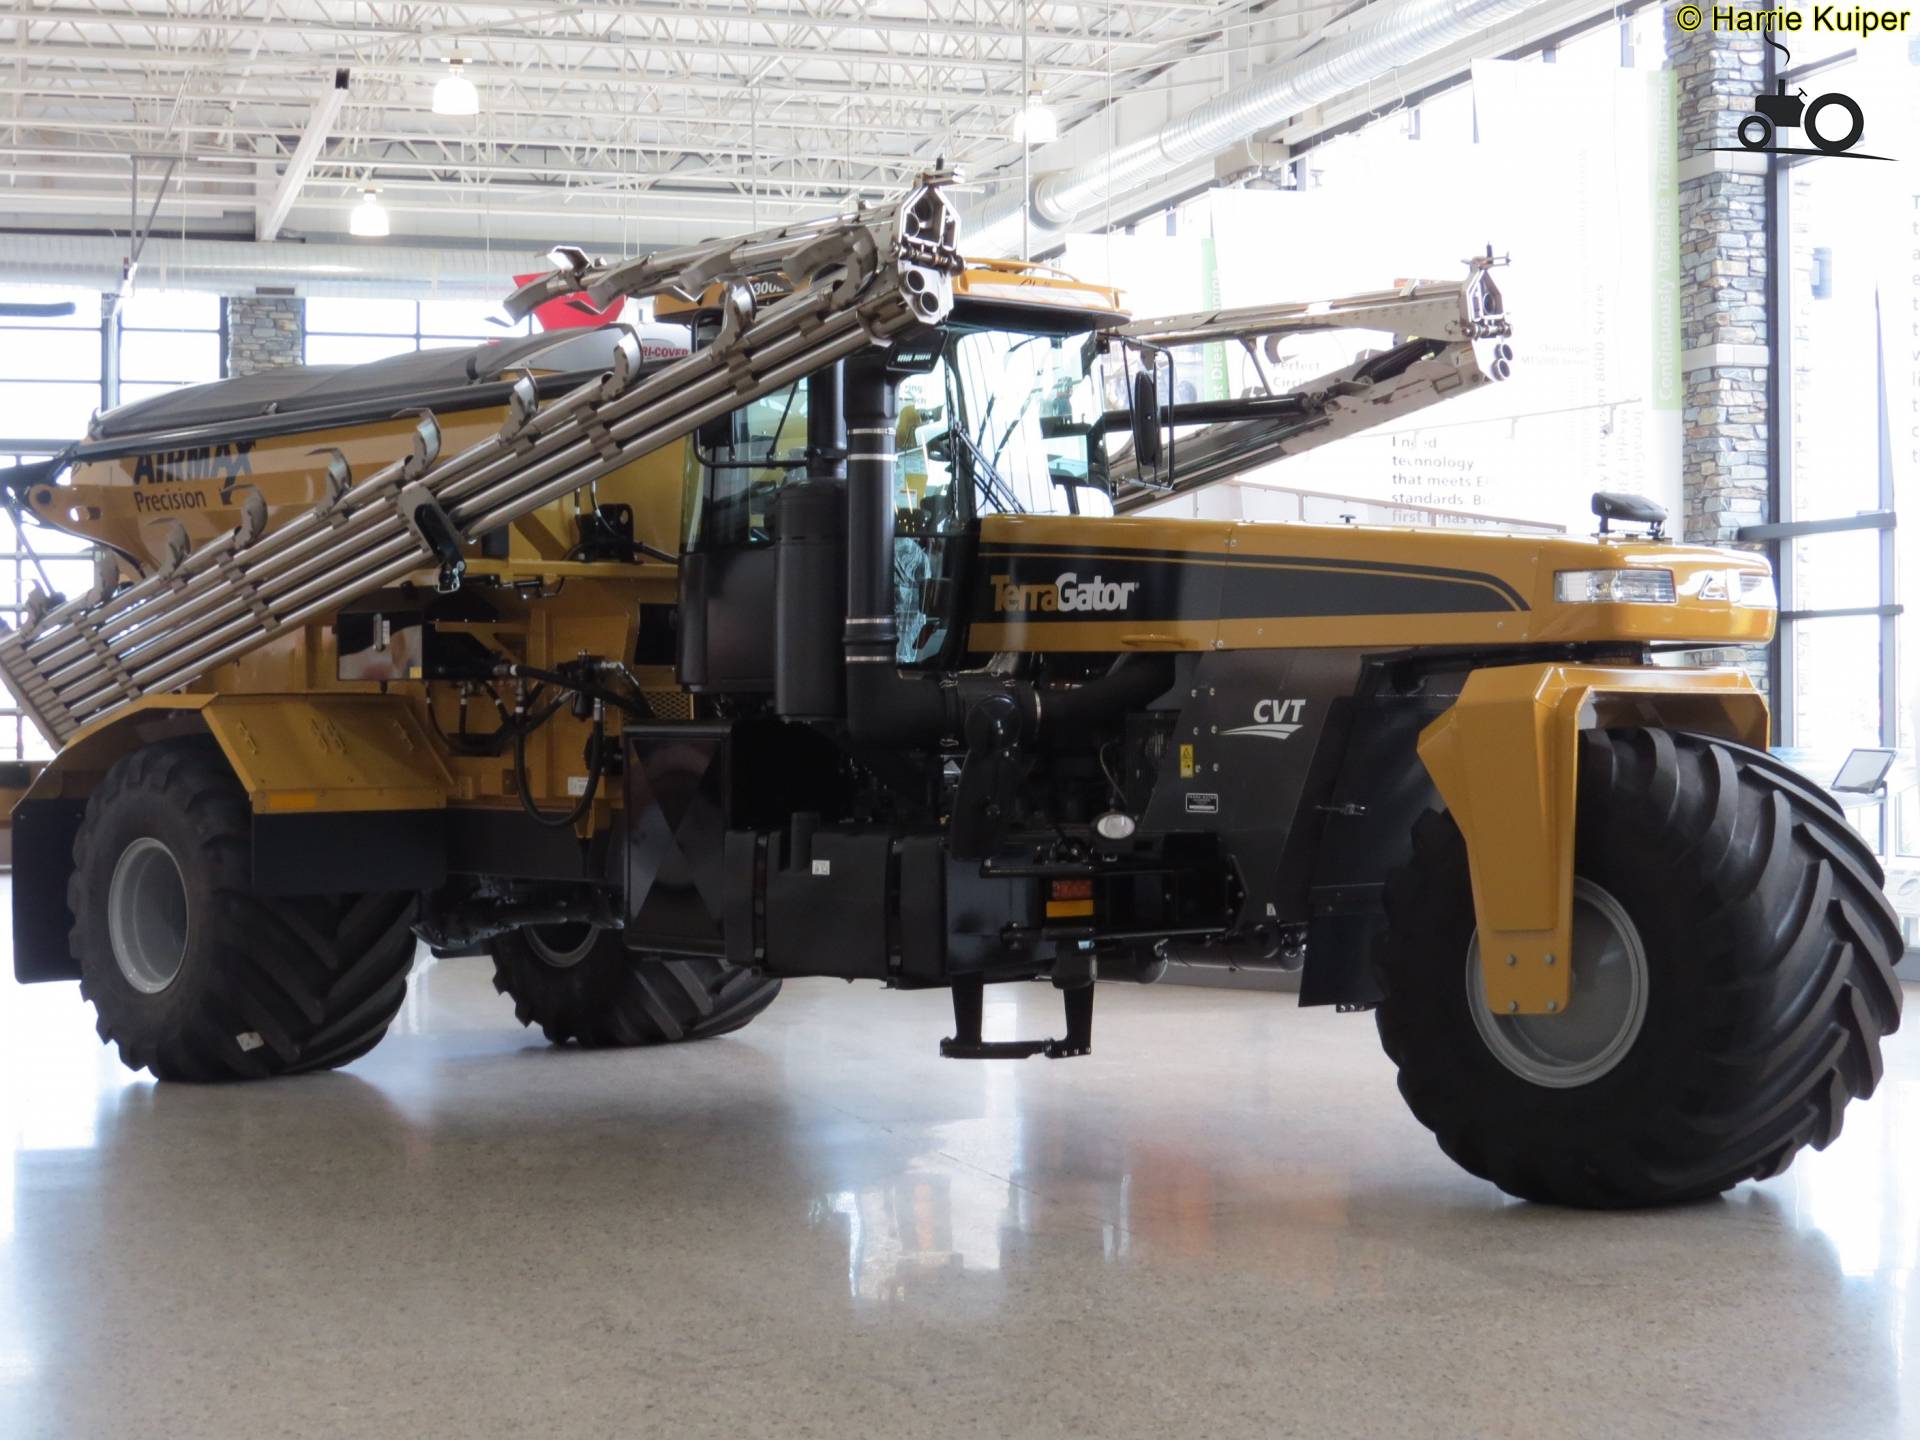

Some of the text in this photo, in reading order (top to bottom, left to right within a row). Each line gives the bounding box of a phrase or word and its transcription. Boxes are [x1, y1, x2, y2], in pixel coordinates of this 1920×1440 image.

[1657, 73, 1676, 402] Continuously Variable Transmission
[1634, 409, 1645, 491] TerraGato
[1392, 473, 1422, 486] that
[1427, 476, 1472, 488] meets
[133, 488, 208, 513] Precision
[1391, 510, 1423, 523] first
[990, 572, 1136, 612] TerraGator
[1253, 699, 1307, 723] CVT
